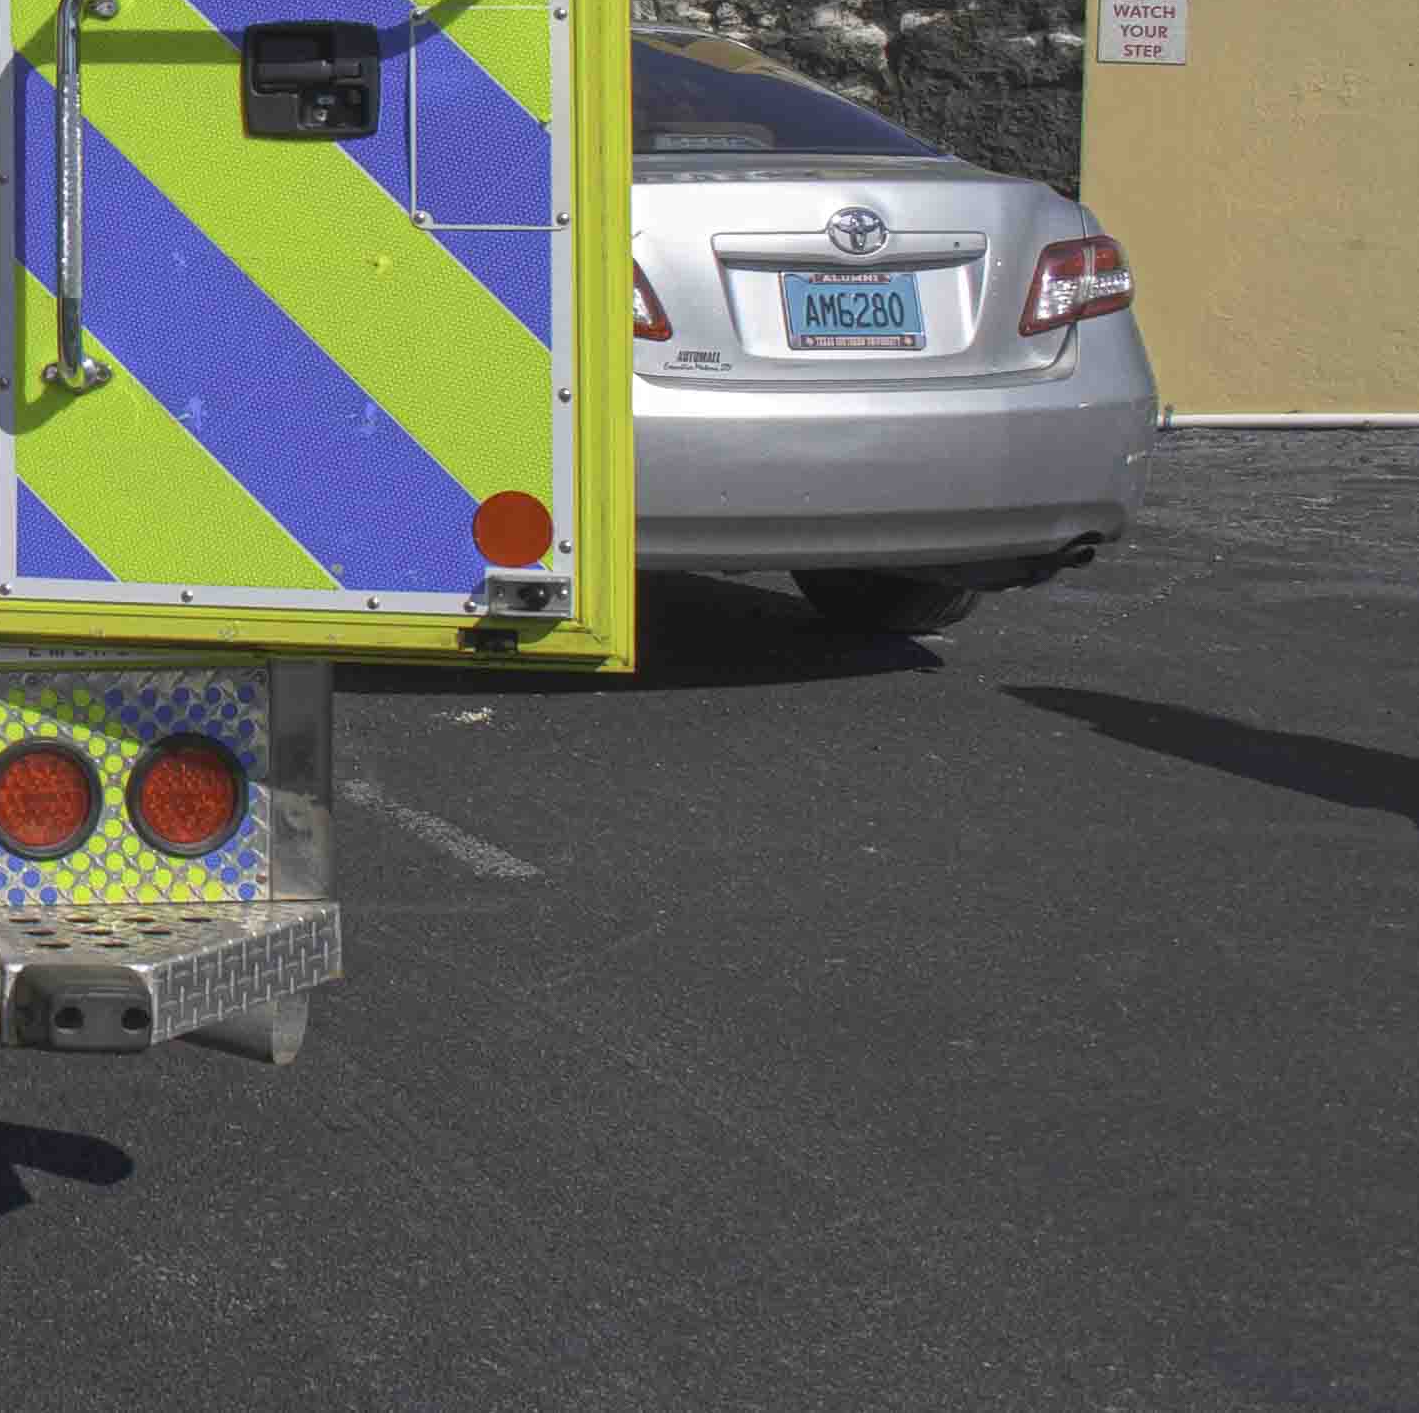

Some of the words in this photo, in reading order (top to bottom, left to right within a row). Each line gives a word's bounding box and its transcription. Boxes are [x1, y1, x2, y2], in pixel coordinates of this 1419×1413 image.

[1113, 4, 1176, 19] WATCH
[1120, 24, 1169, 38] YOUR
[1123, 44, 1162, 58] STEP
[822, 274, 879, 283] ALUMNI
[805, 291, 905, 329] AM6280
